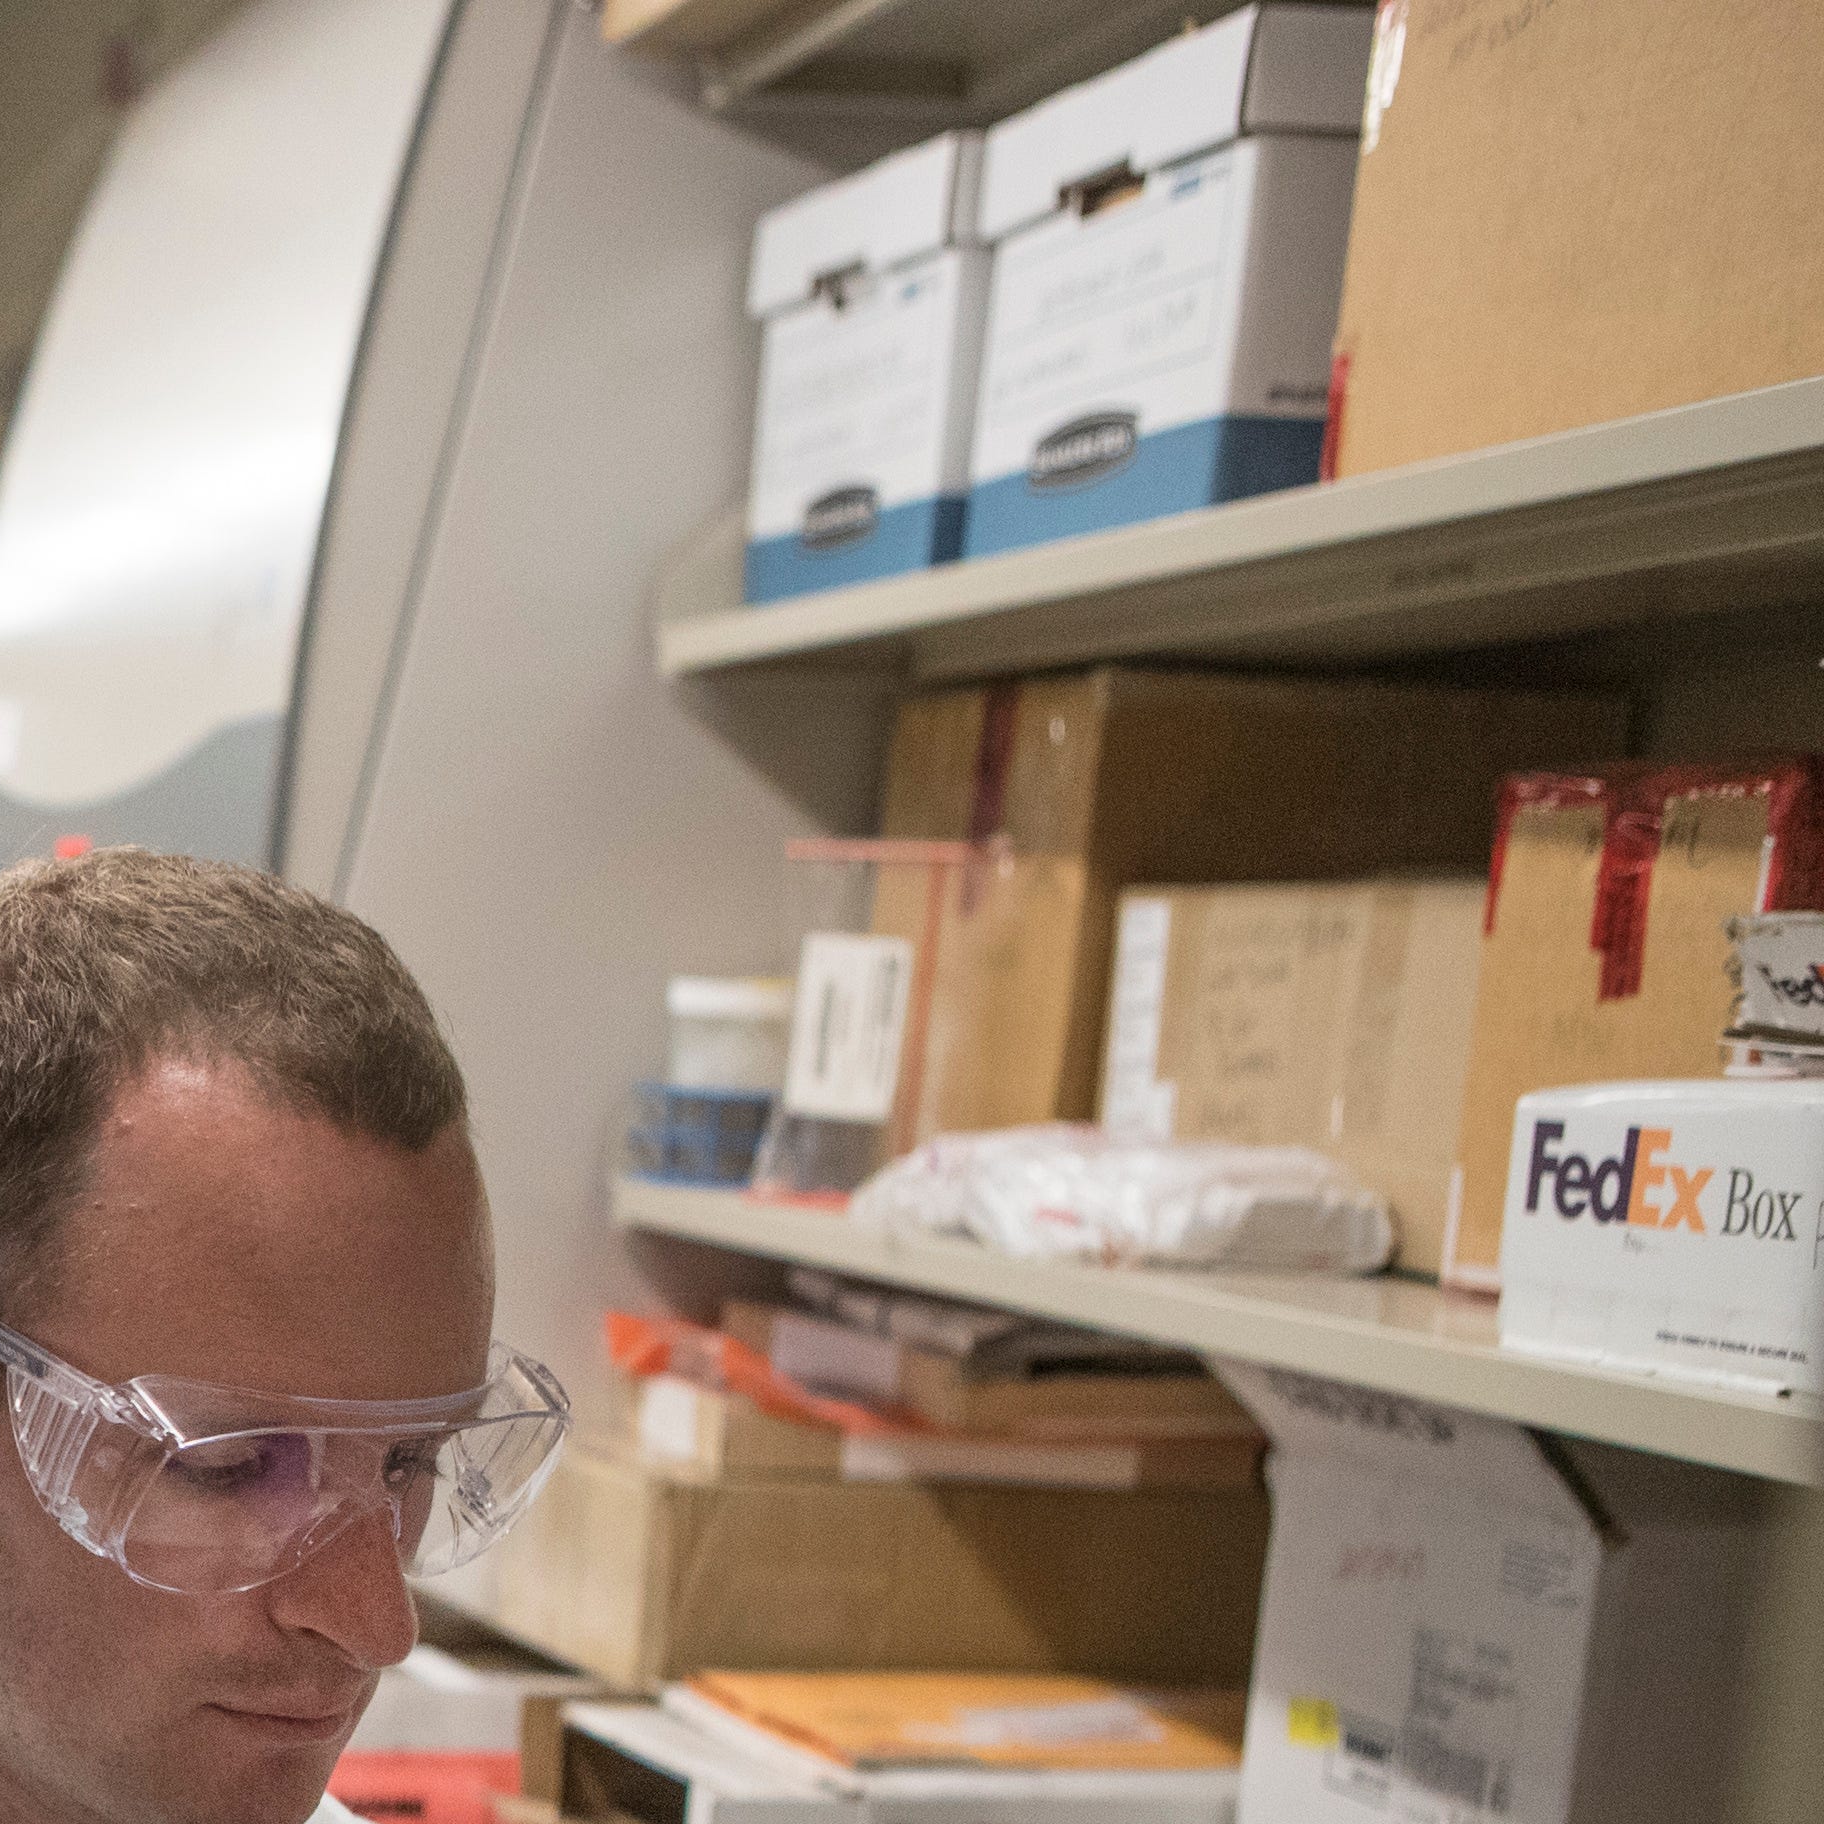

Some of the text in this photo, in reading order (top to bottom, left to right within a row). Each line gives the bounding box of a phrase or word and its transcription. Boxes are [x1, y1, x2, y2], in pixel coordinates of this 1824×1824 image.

[1755, 961, 1824, 1008] Fed
[1525, 1119, 1802, 1242] FedEx Box
